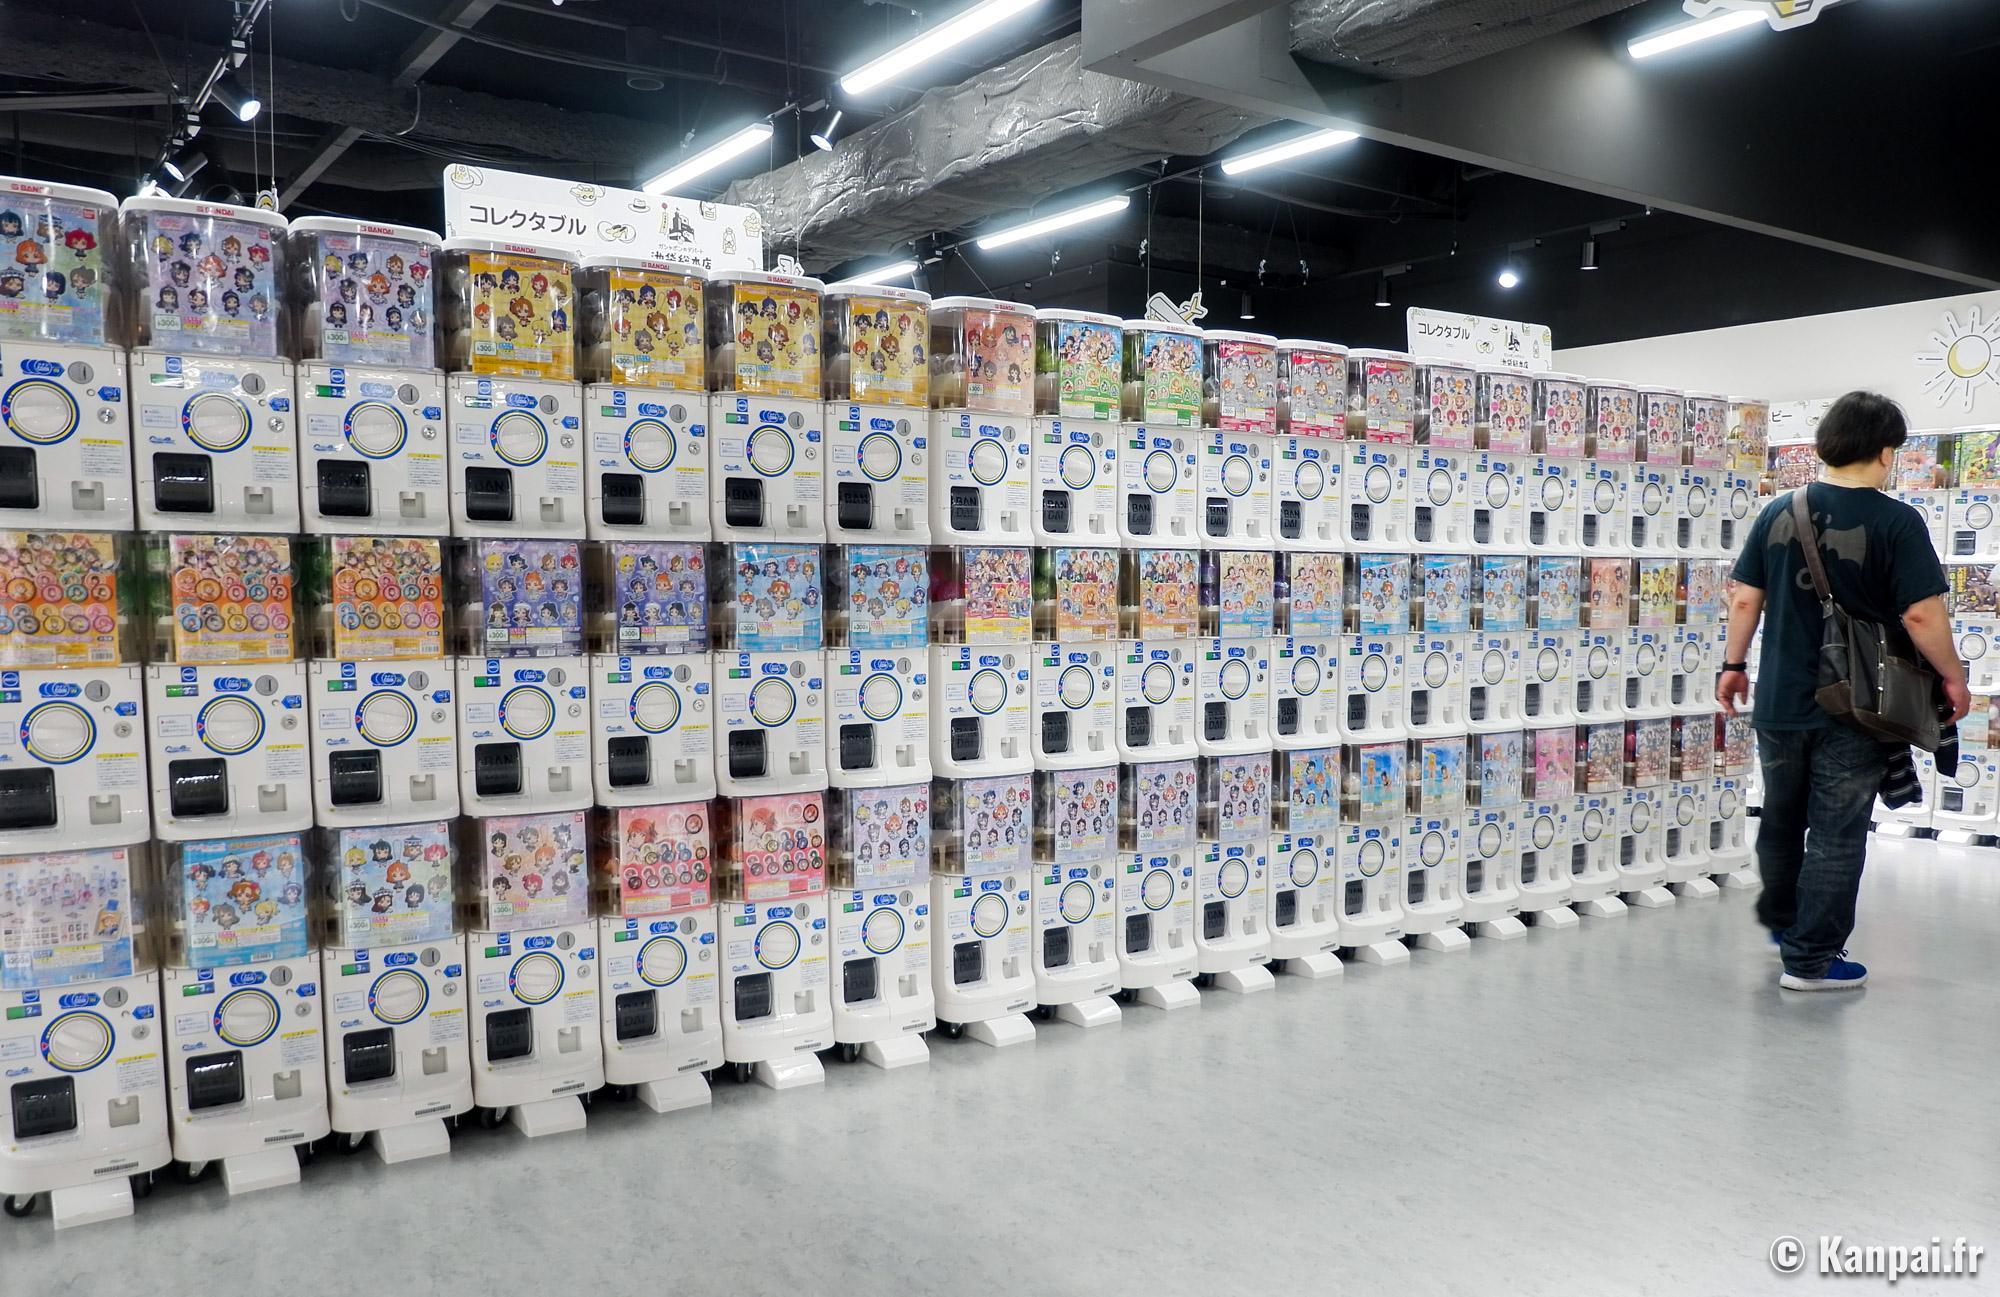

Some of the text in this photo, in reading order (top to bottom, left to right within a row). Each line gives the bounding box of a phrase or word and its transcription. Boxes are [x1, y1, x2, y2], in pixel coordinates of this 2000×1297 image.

[469, 205, 587, 236] コレクタブル
[511, 245, 536, 254] BANDAI
[648, 262, 670, 270] BANDAI
[1418, 322, 1470, 340] コレクタブル
[1769, 410, 1792, 422] ビー
